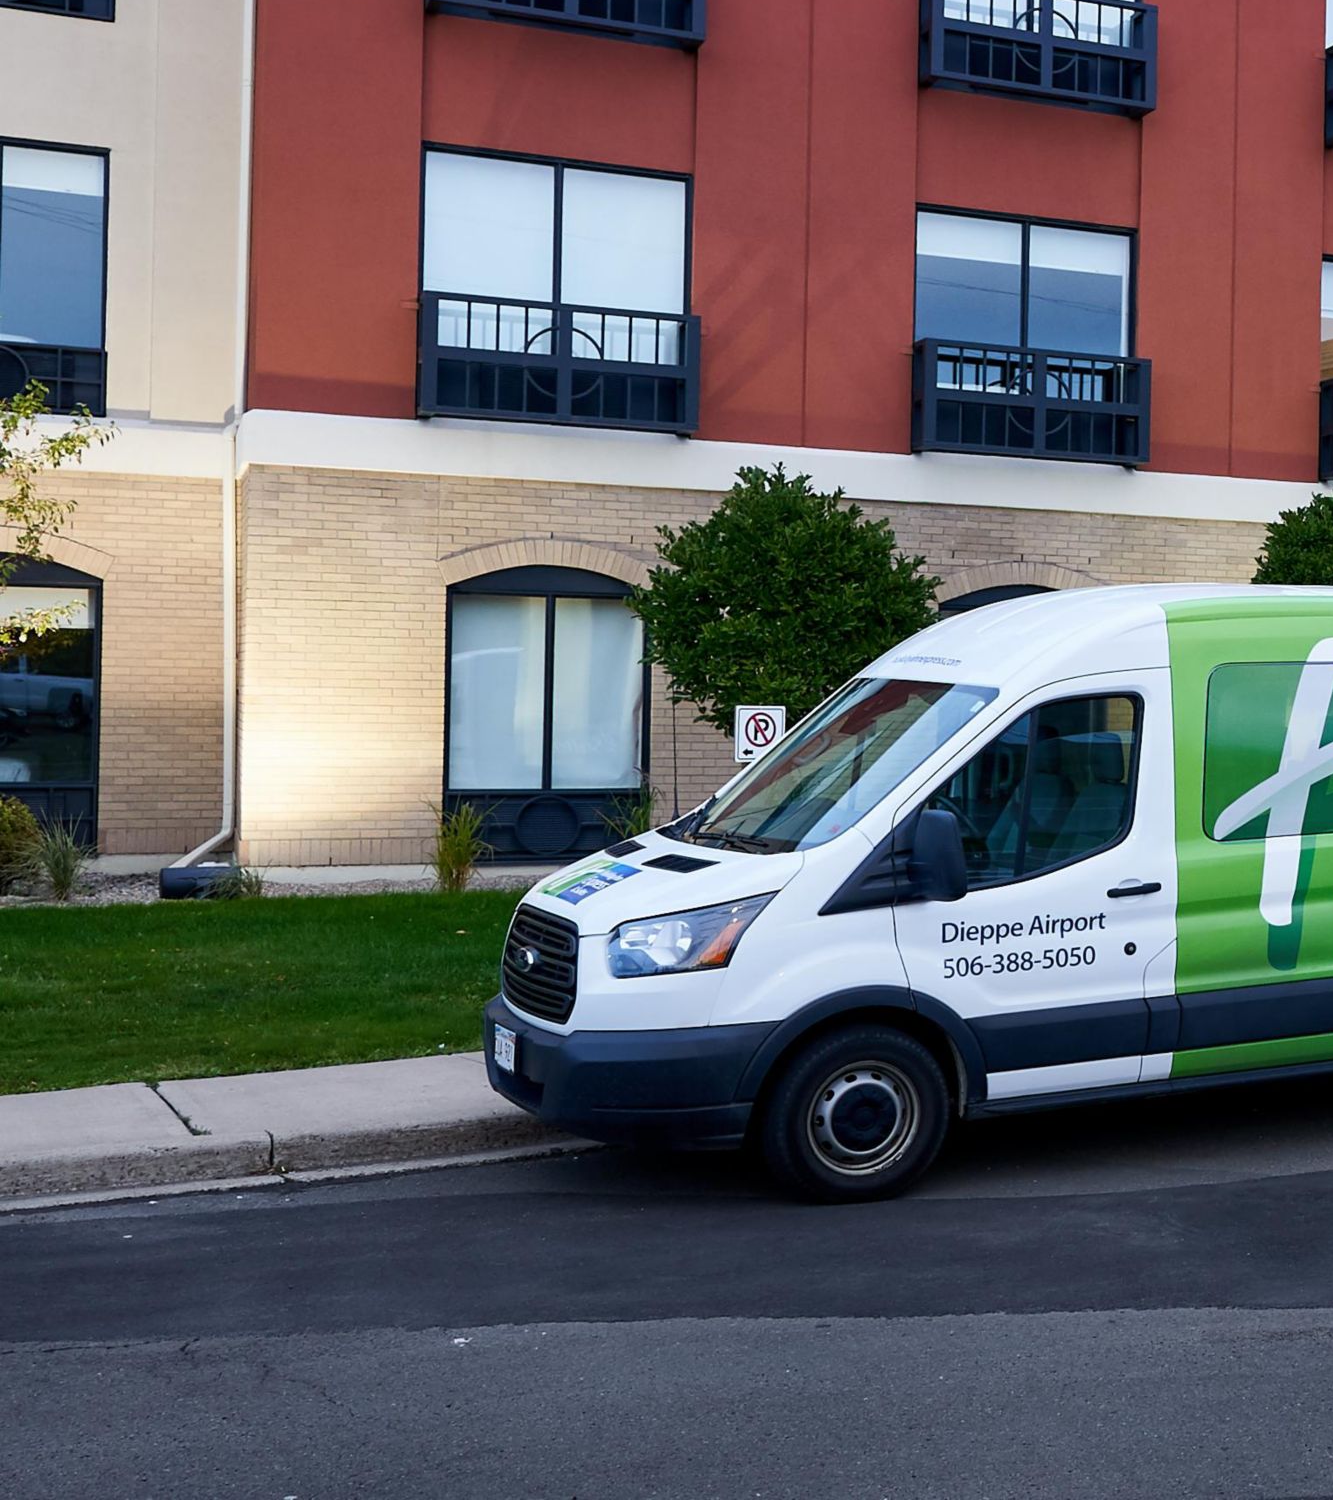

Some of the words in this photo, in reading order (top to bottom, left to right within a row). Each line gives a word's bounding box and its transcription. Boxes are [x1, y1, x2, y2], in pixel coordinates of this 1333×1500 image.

[942, 921, 1024, 945] Dieppe
[1028, 912, 1107, 938] Airport
[943, 945, 1096, 979] 506-388-5050
